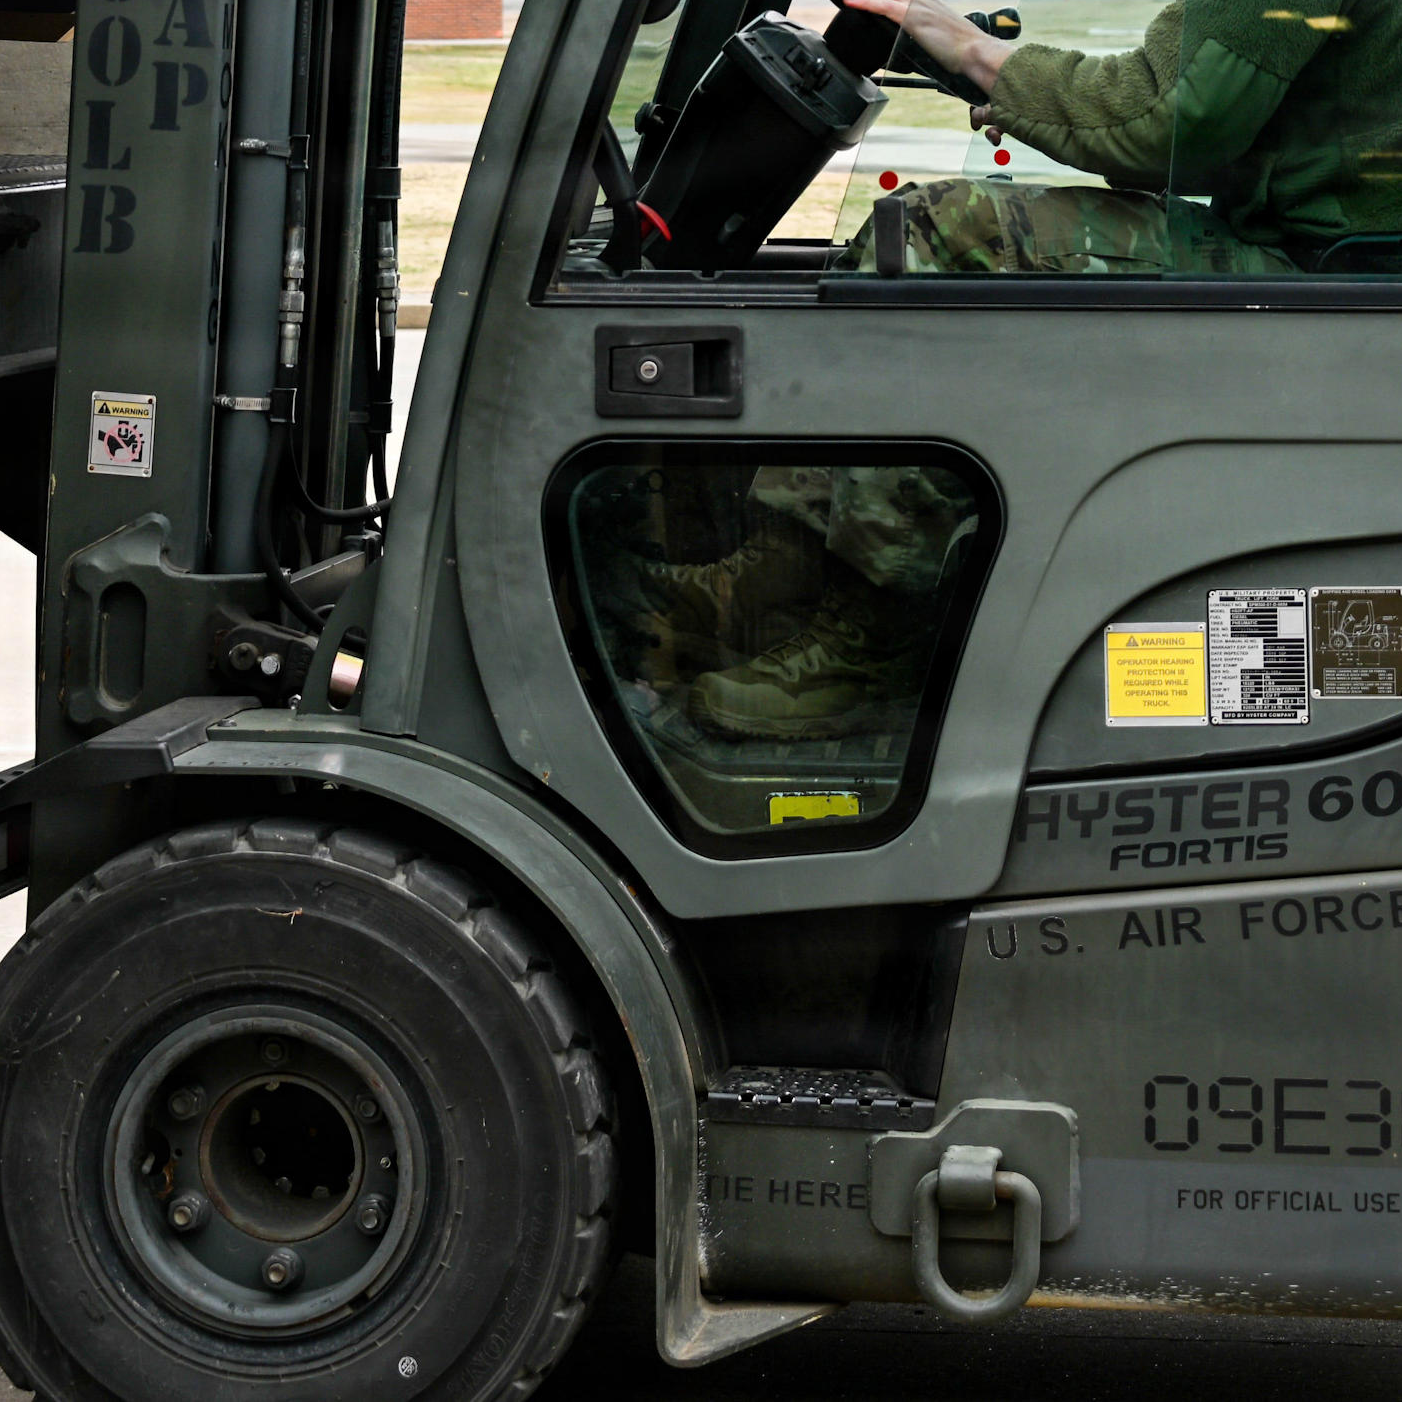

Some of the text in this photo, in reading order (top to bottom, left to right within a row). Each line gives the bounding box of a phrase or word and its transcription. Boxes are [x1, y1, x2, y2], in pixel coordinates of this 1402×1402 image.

[112, 406, 150, 416] WARNING
[1141, 637, 1185, 646] WARNING
[1016, 778, 1292, 843] HYSTER
[1109, 832, 1290, 872] FORTIS
[1118, 906, 1207, 951] AIR
[706, 1174, 869, 1210] TIE HERE
[1176, 1188, 1223, 1210] FOR
[1234, 1189, 1343, 1213] OFFICIAL
[1354, 1192, 1401, 1213] USE
